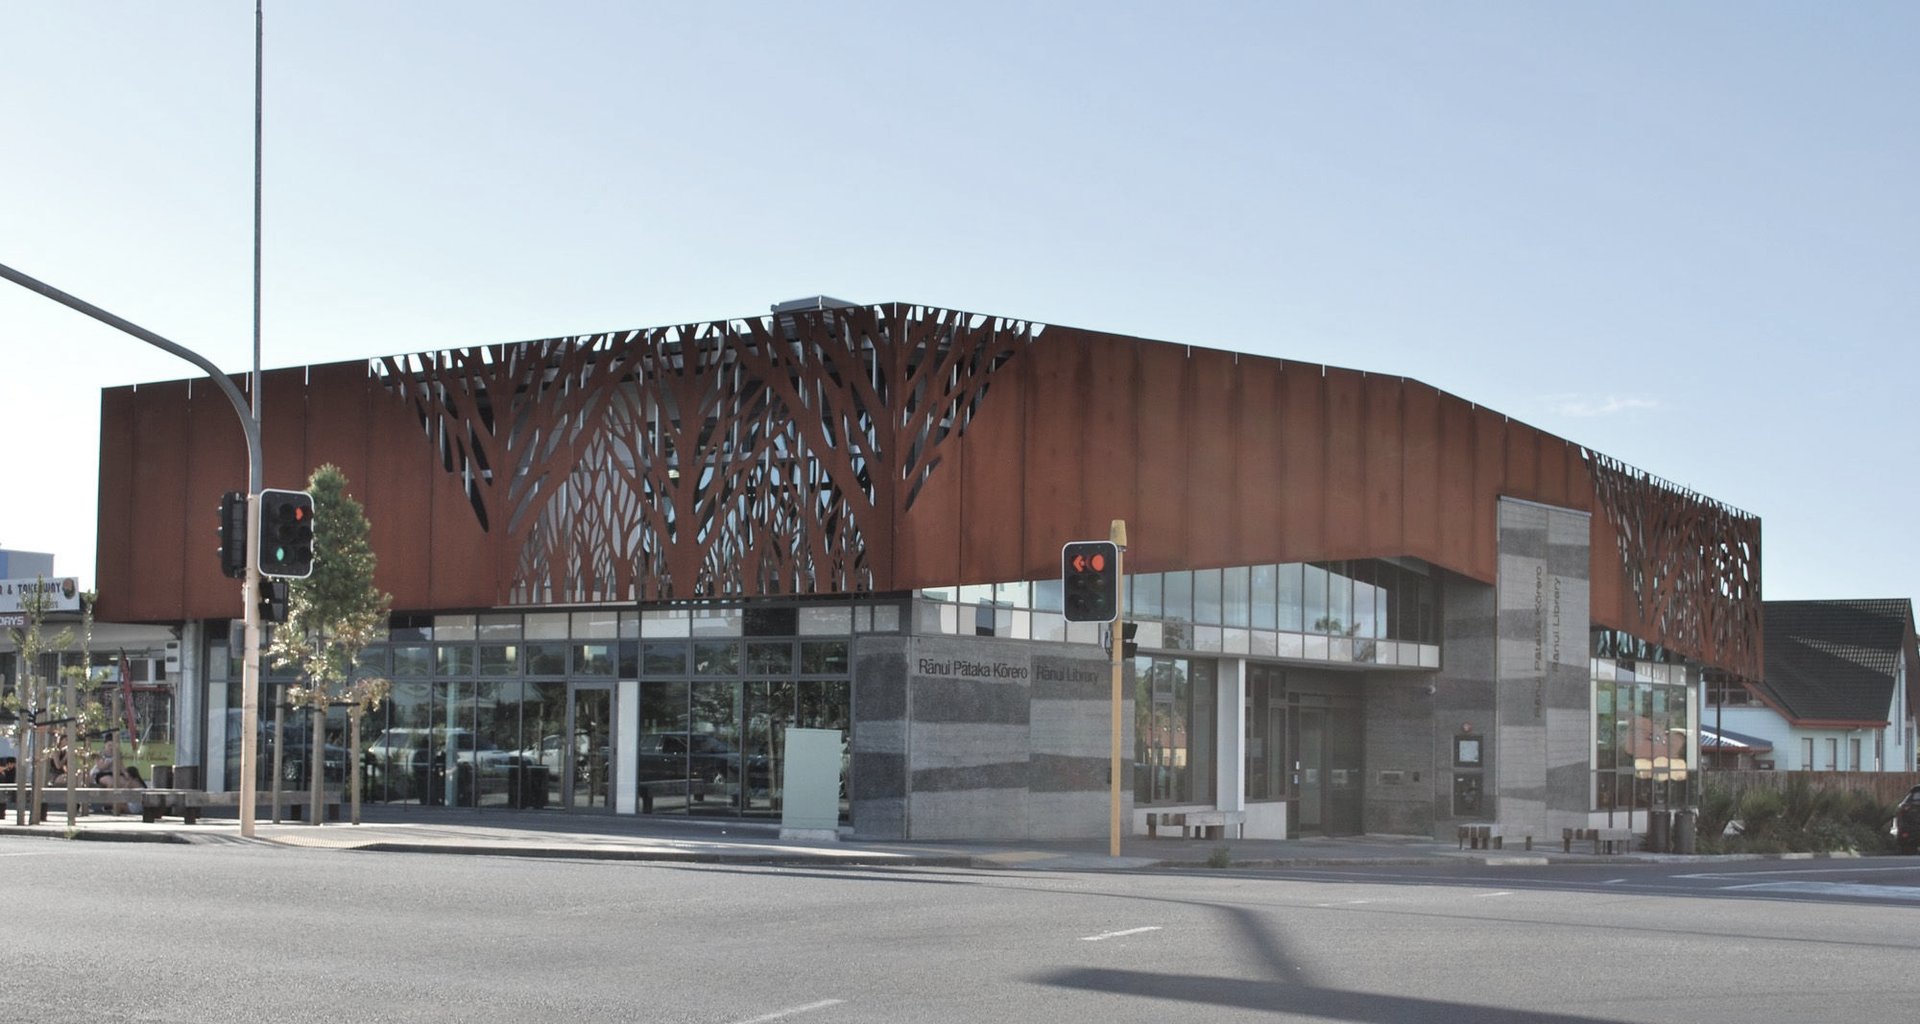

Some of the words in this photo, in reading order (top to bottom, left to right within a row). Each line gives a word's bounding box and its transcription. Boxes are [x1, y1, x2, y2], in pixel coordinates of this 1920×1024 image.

[17, 582, 60, 595] TAKEWAY
[1552, 576, 1560, 626] Library
[919, 658, 950, 675] Rānui
[953, 660, 991, 678] Pātaka
[993, 662, 1028, 679] Kōrero
[1036, 665, 1064, 682] Rānui
[1066, 667, 1099, 686] Library
